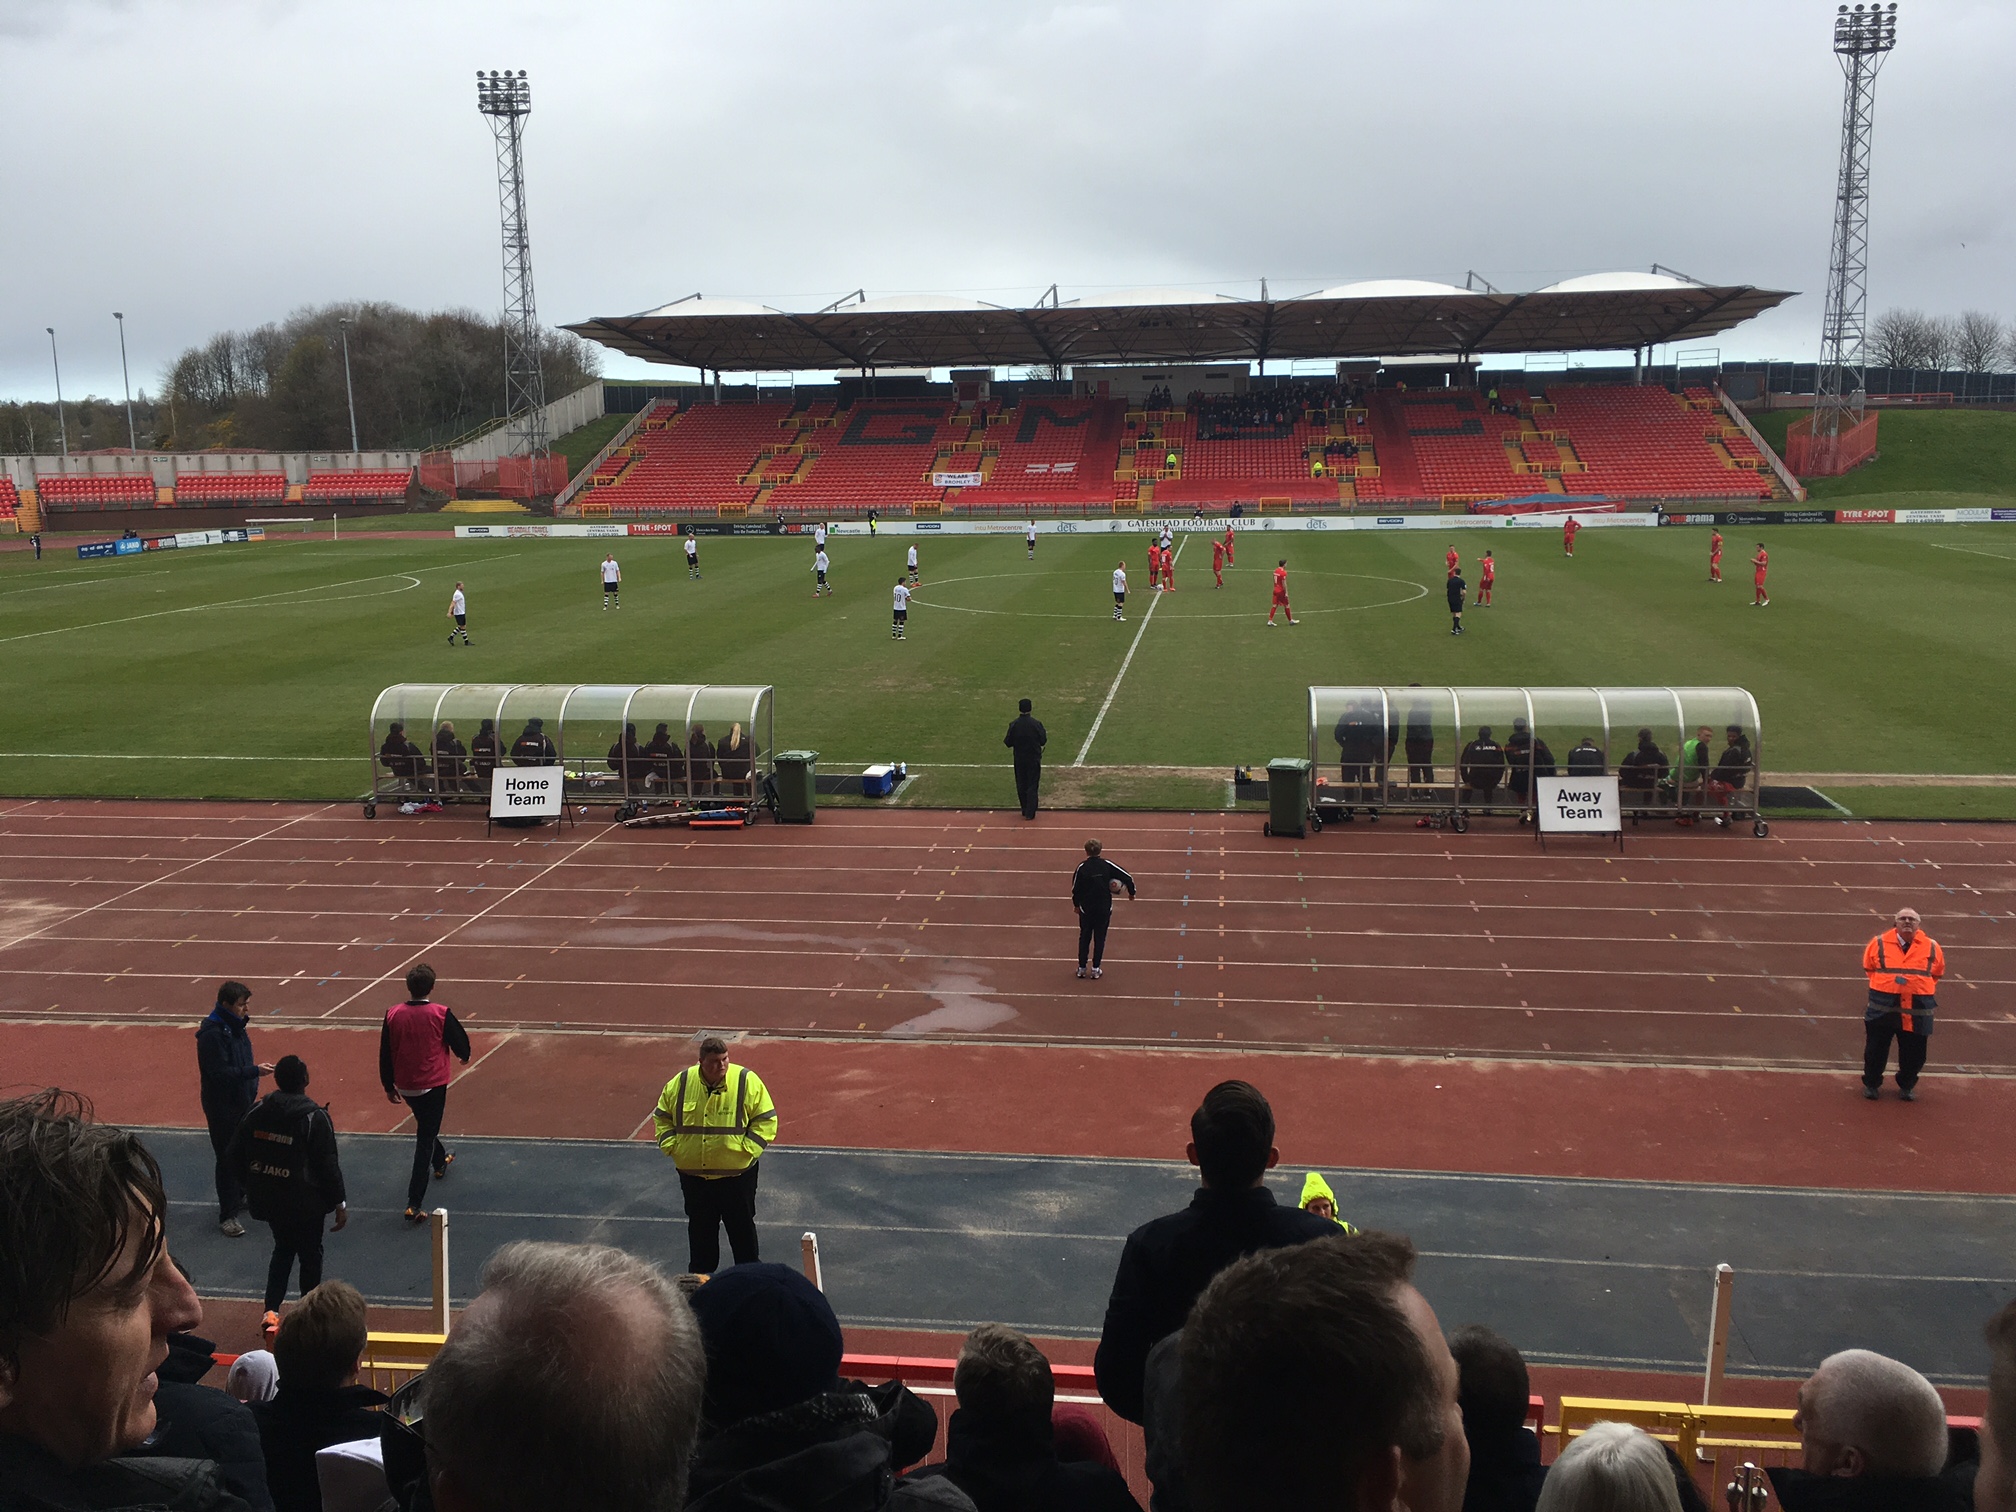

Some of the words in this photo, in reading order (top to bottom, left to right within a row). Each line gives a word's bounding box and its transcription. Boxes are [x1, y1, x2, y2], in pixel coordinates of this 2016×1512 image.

[1670, 514, 1715, 522] vanarama
[1842, 510, 1862, 518] TYRE
[1867, 510, 1889, 518] SPOT
[1127, 519, 1180, 528] GATESHEAD
[1182, 519, 1230, 528] FOOTBALL
[1231, 518, 1256, 527] CLUB
[894, 593, 902, 603] 10
[505, 778, 549, 791] Home
[506, 793, 546, 806] Team
[1557, 789, 1602, 805] Away
[1556, 805, 1603, 819] Team
[262, 1165, 290, 1178] JAKO
